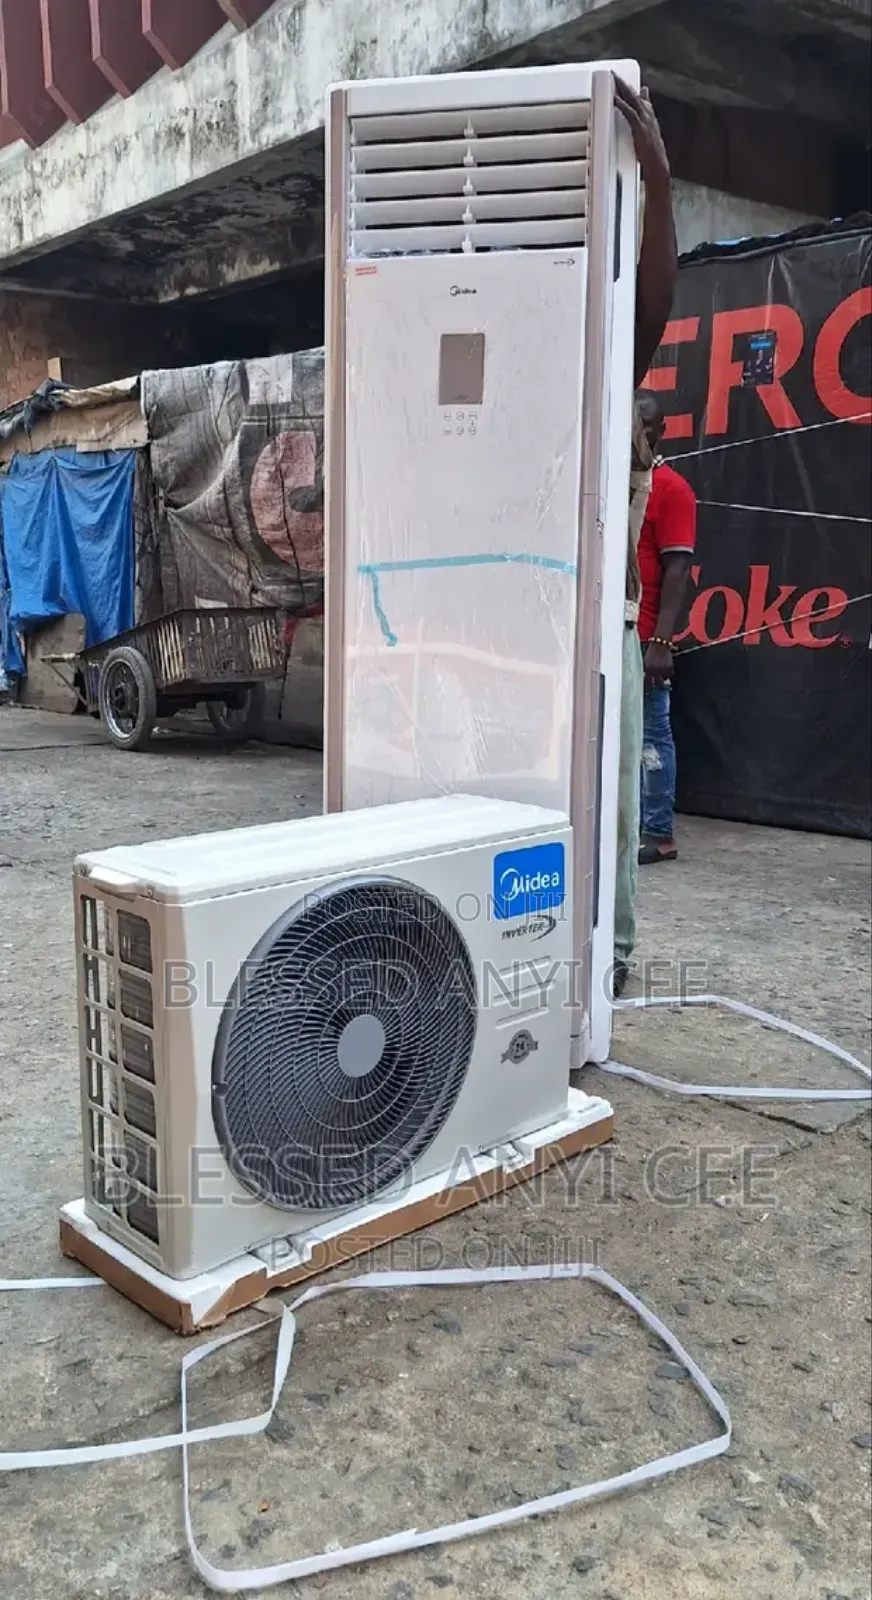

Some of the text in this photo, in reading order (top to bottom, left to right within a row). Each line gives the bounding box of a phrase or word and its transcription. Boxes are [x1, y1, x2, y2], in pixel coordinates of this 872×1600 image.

[449, 284, 478, 298] Midea
[673, 565, 849, 649] oke
[500, 867, 560, 901] Midea
[502, 922, 544, 939] INVERTER
